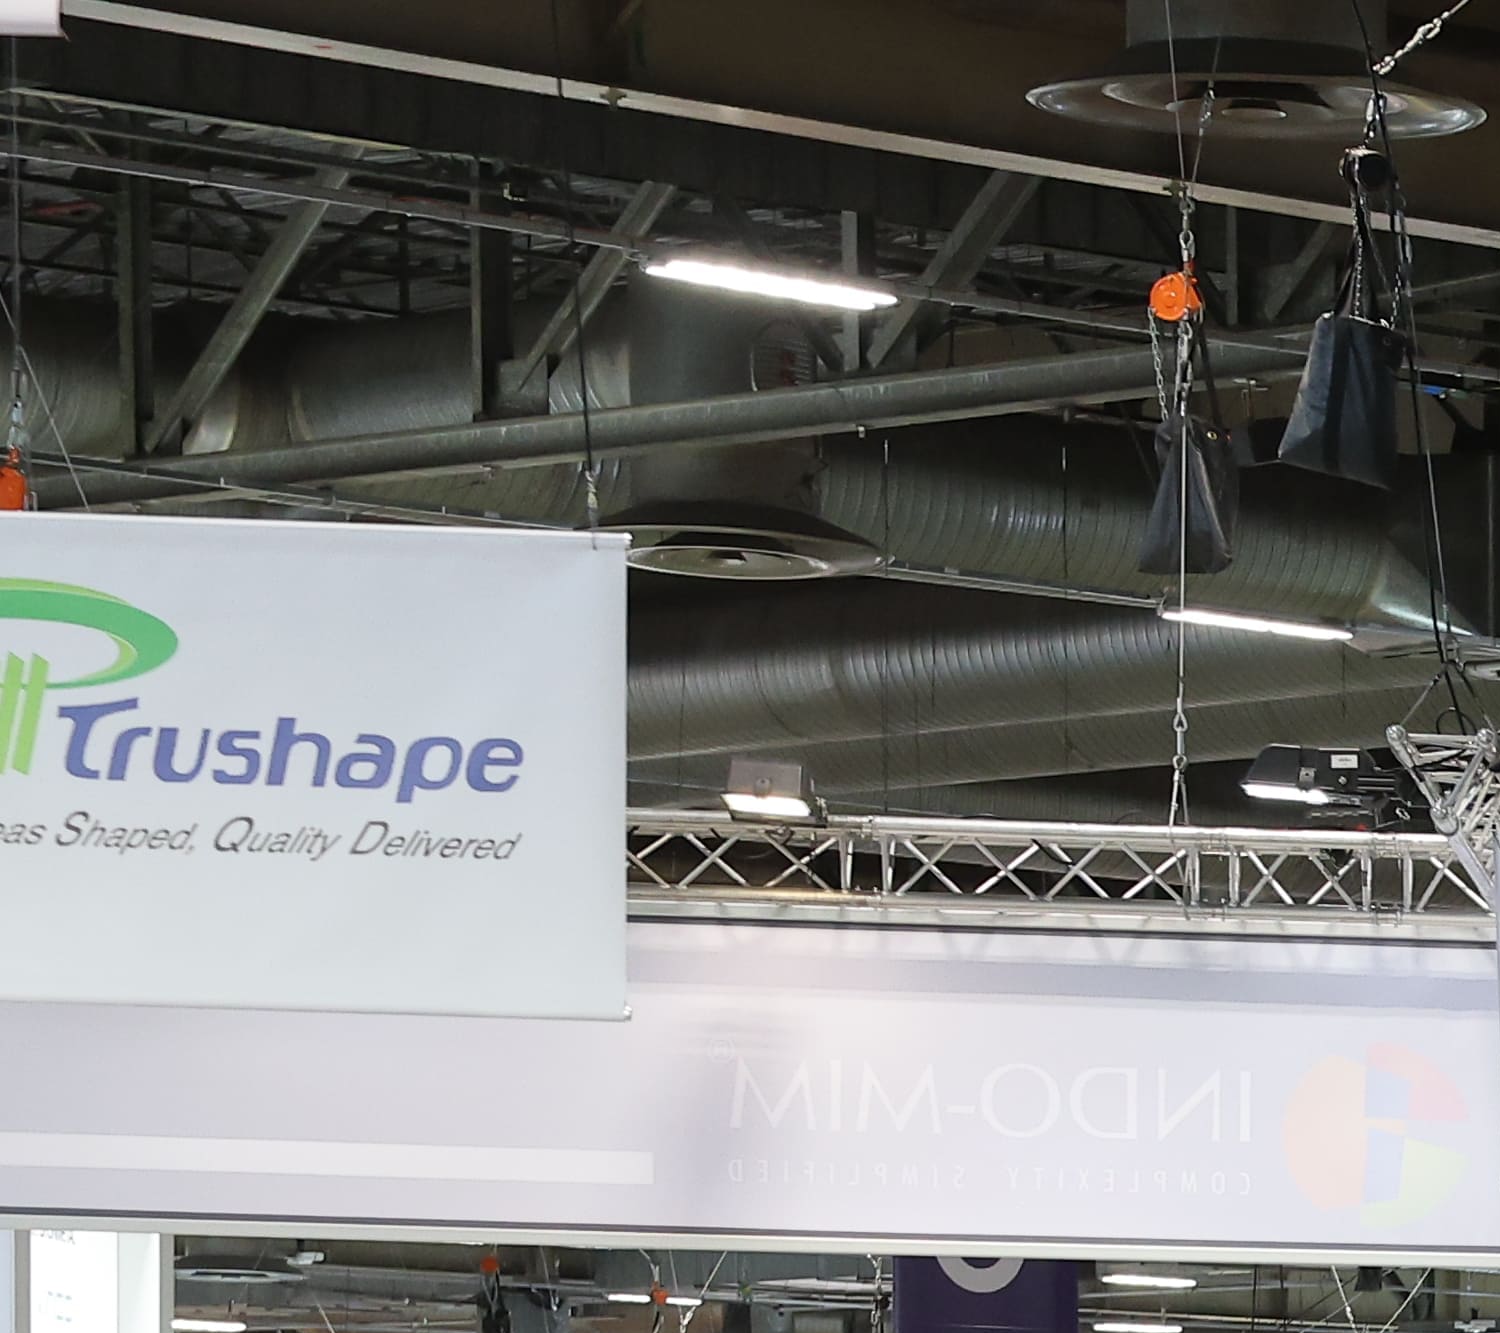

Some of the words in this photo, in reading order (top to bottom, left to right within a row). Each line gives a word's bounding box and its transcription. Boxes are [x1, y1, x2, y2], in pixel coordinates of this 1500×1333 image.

[58, 699, 523, 803] Trushape
[55, 813, 196, 854] Shaped,
[213, 817, 341, 860] Quality
[349, 822, 520, 861] Delivered
